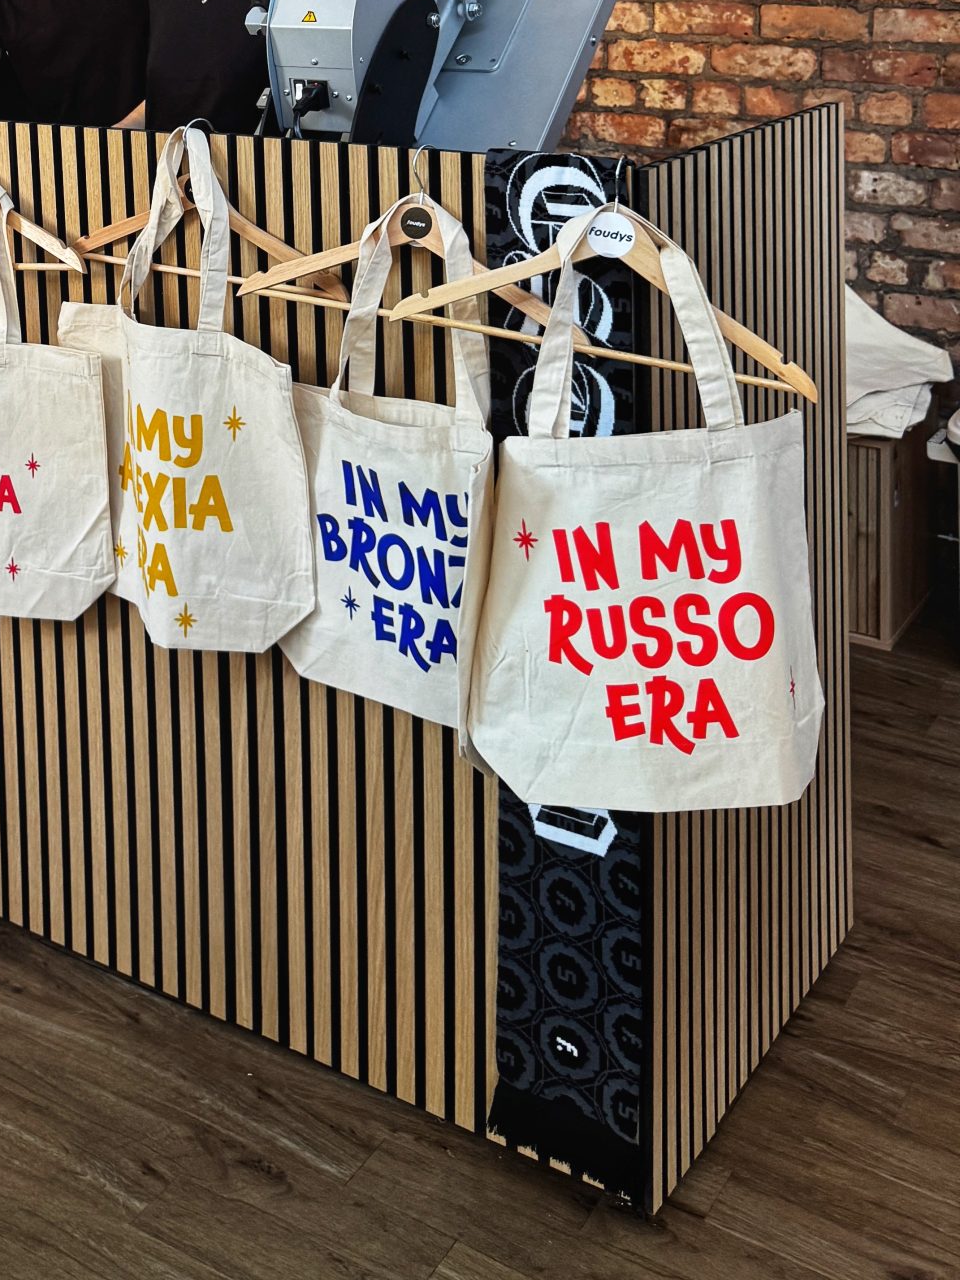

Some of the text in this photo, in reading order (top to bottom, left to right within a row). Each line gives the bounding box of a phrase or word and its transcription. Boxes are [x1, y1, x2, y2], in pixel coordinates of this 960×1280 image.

[589, 226, 633, 242] foudys
[341, 459, 389, 523] IN
[552, 520, 620, 592] IN
[371, 594, 458, 673] ERA
[544, 591, 776, 676] RUSSO
[605, 674, 740, 756] ERA
